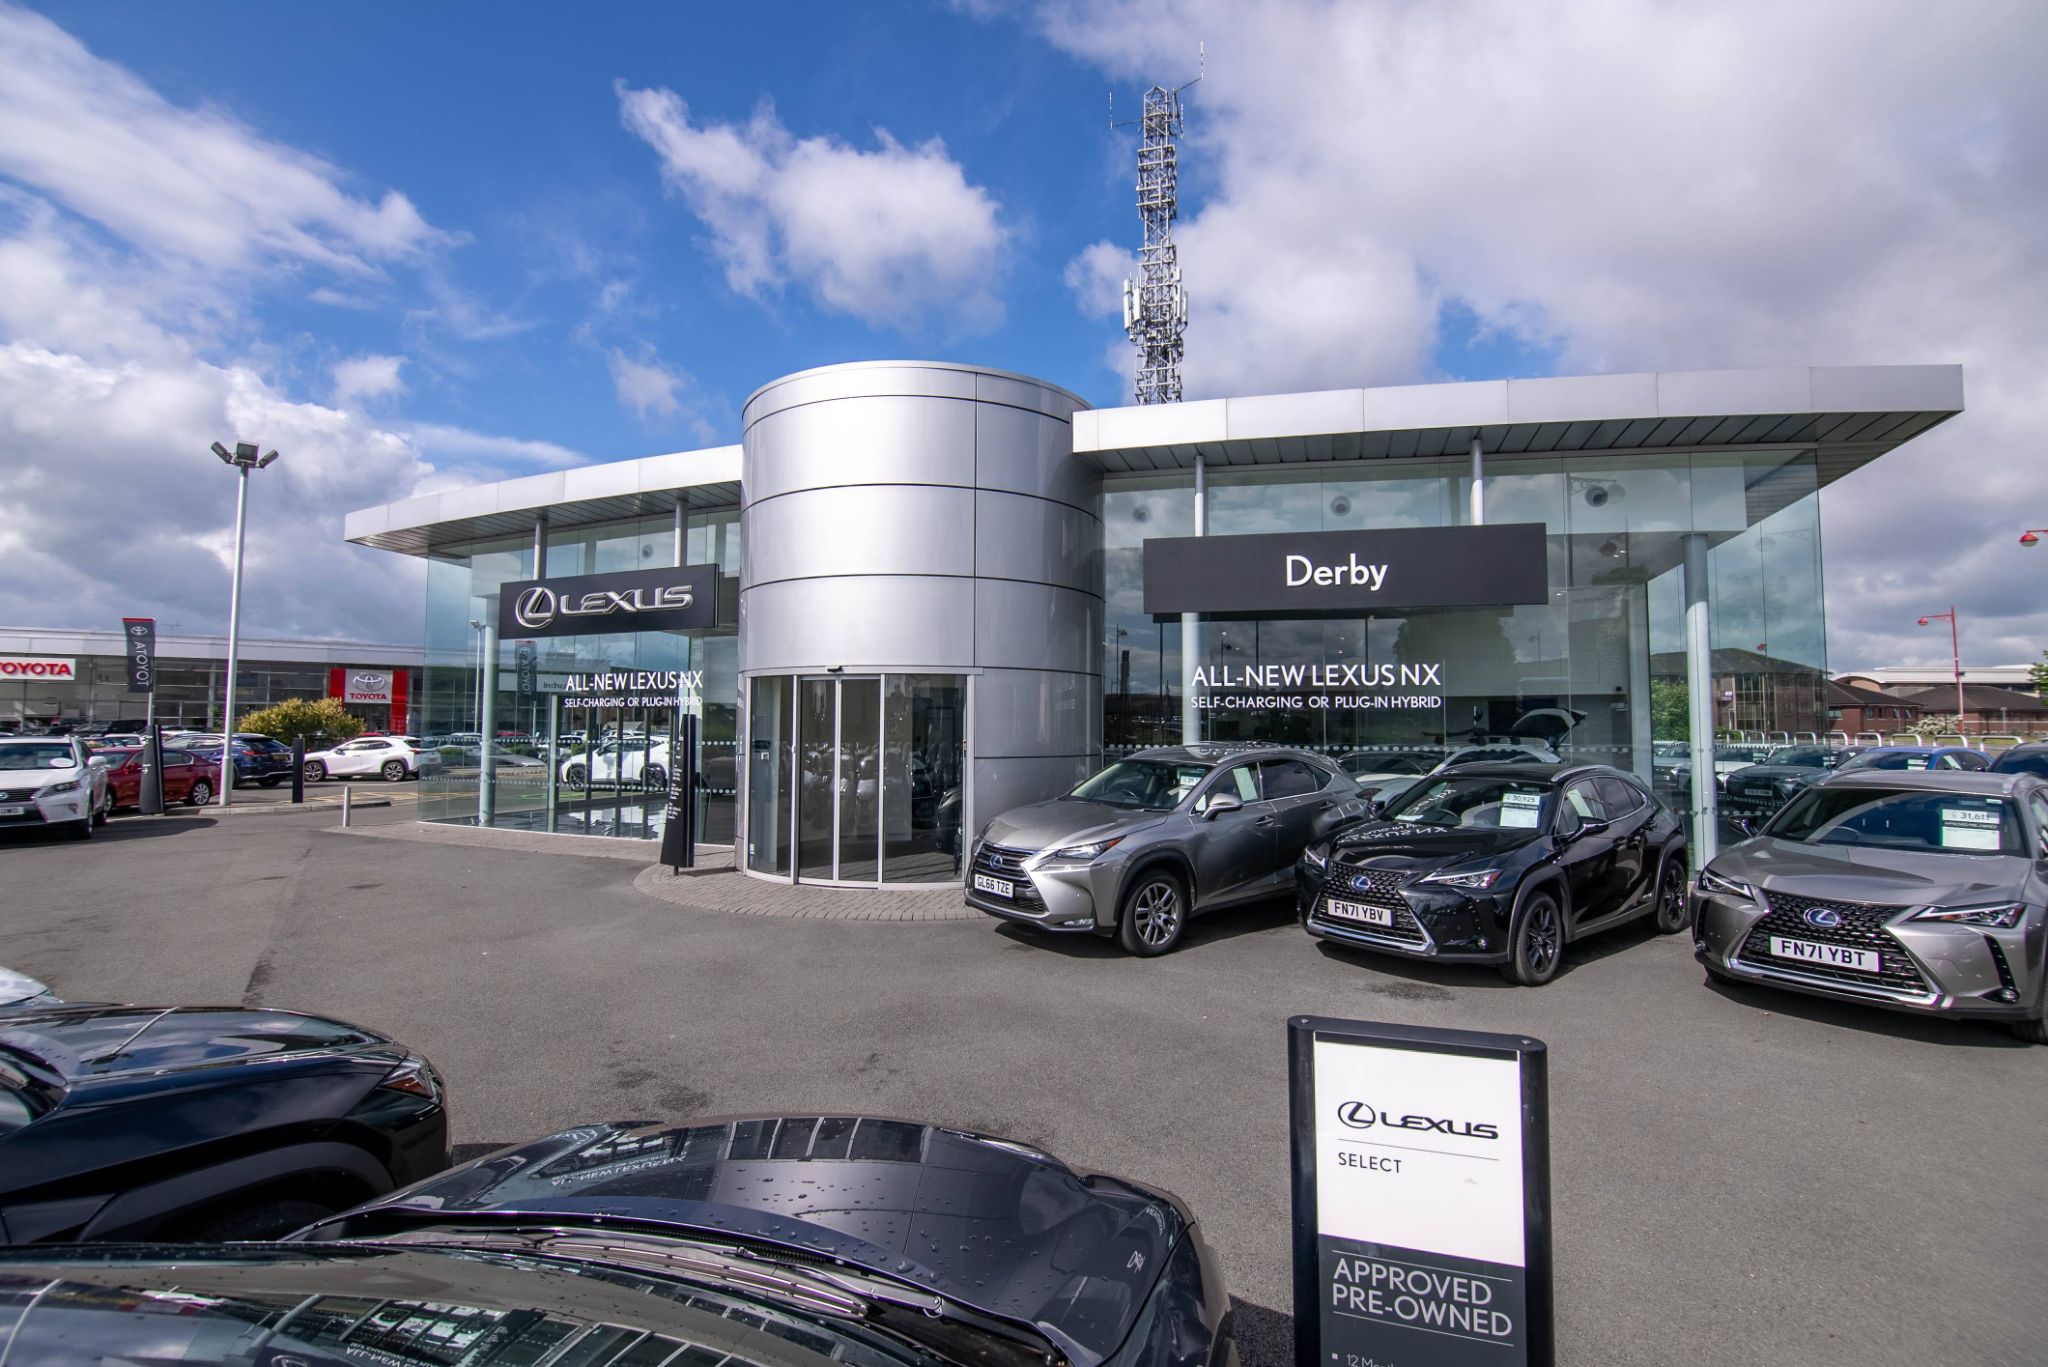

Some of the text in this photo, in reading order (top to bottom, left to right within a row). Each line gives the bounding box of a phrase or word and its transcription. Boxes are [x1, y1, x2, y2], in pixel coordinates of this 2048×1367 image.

[1286, 553, 1389, 591] Derby
[561, 585, 693, 615] LEXUS
[0, 662, 72, 676] OYOTA
[1191, 664, 1441, 687] ALL-NEW LEXUS NX
[565, 670, 703, 691] ALL-NEW LEXUS NX
[564, 696, 702, 708] SELF-CHARGING OR PLUG-IN HYBRID
[1191, 696, 1441, 708] SELF-CHARGING OR PLUG-IN HYBRID
[977, 877, 1010, 894] GL66 TZE
[1334, 902, 1383, 921] FN71 YBV
[1781, 940, 1865, 966] FN71 YBT
[1381, 1112, 1499, 1139] LEXUS
[1338, 1152, 1402, 1173] SELECT
[1333, 1257, 1492, 1305] APPROVED
[1332, 1283, 1512, 1336] PRE-OWNED
[1347, 1354, 1359, 1367] 12
